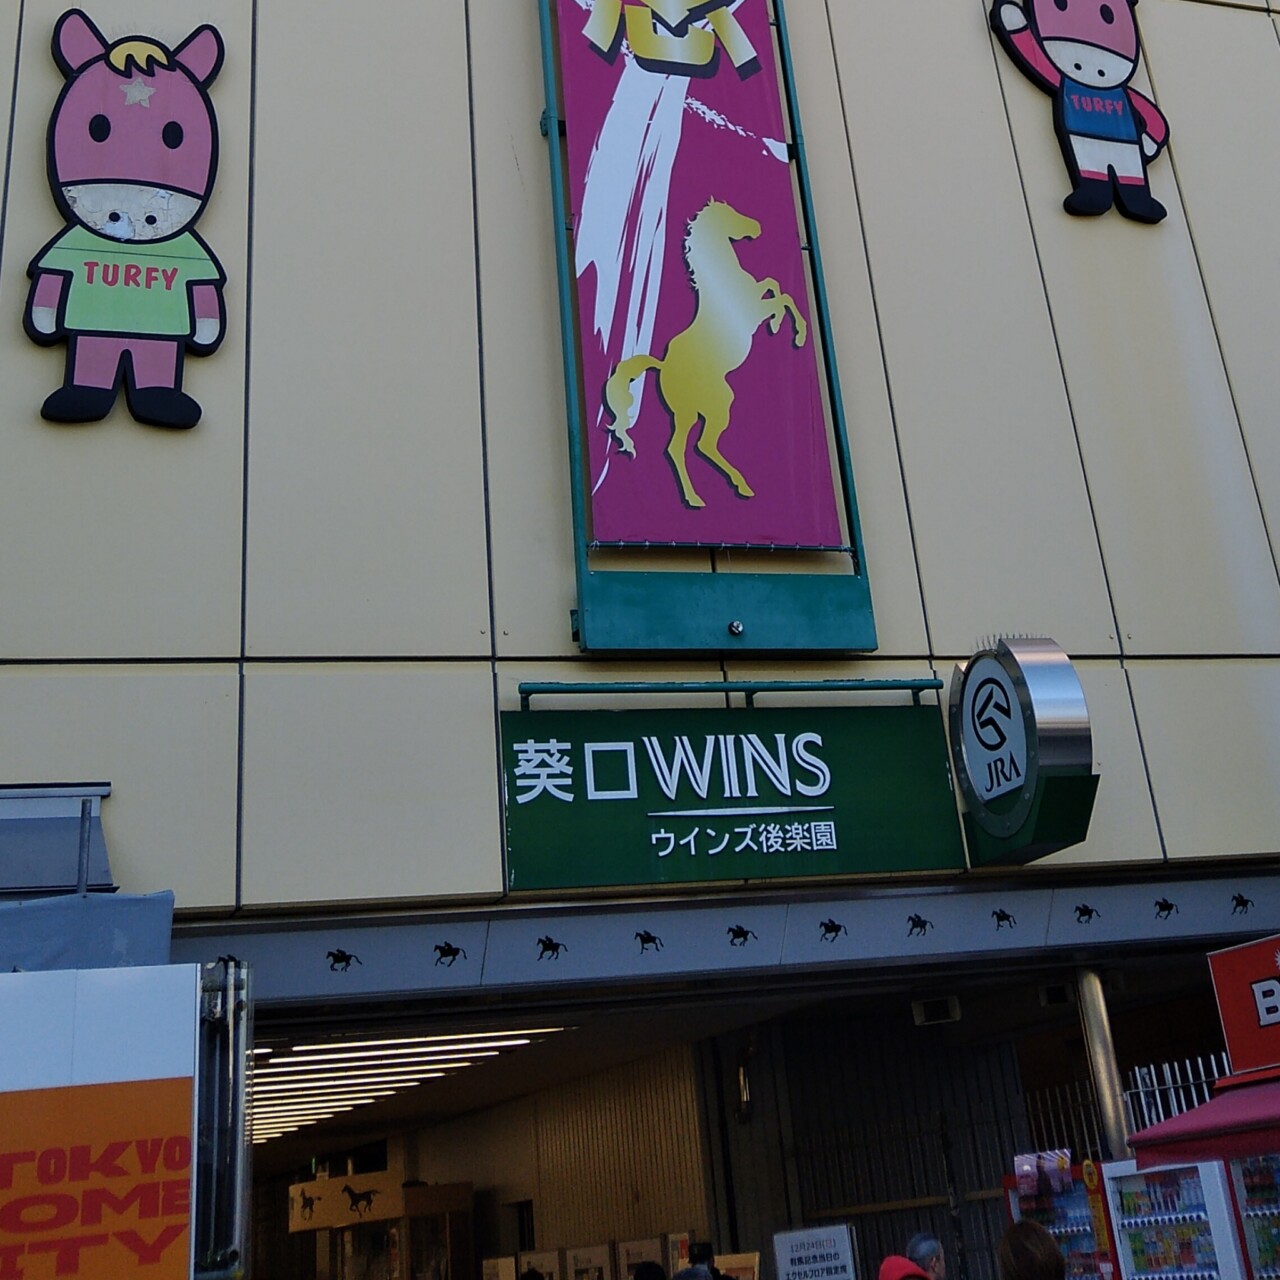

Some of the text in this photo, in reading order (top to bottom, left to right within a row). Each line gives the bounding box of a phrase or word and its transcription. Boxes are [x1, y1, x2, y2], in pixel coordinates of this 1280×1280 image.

[1071, 95, 1123, 116] TURFY
[84, 262, 178, 291] TURFY
[985, 751, 1021, 792] JRA
[651, 821, 837, 856] ウインズ後楽園
